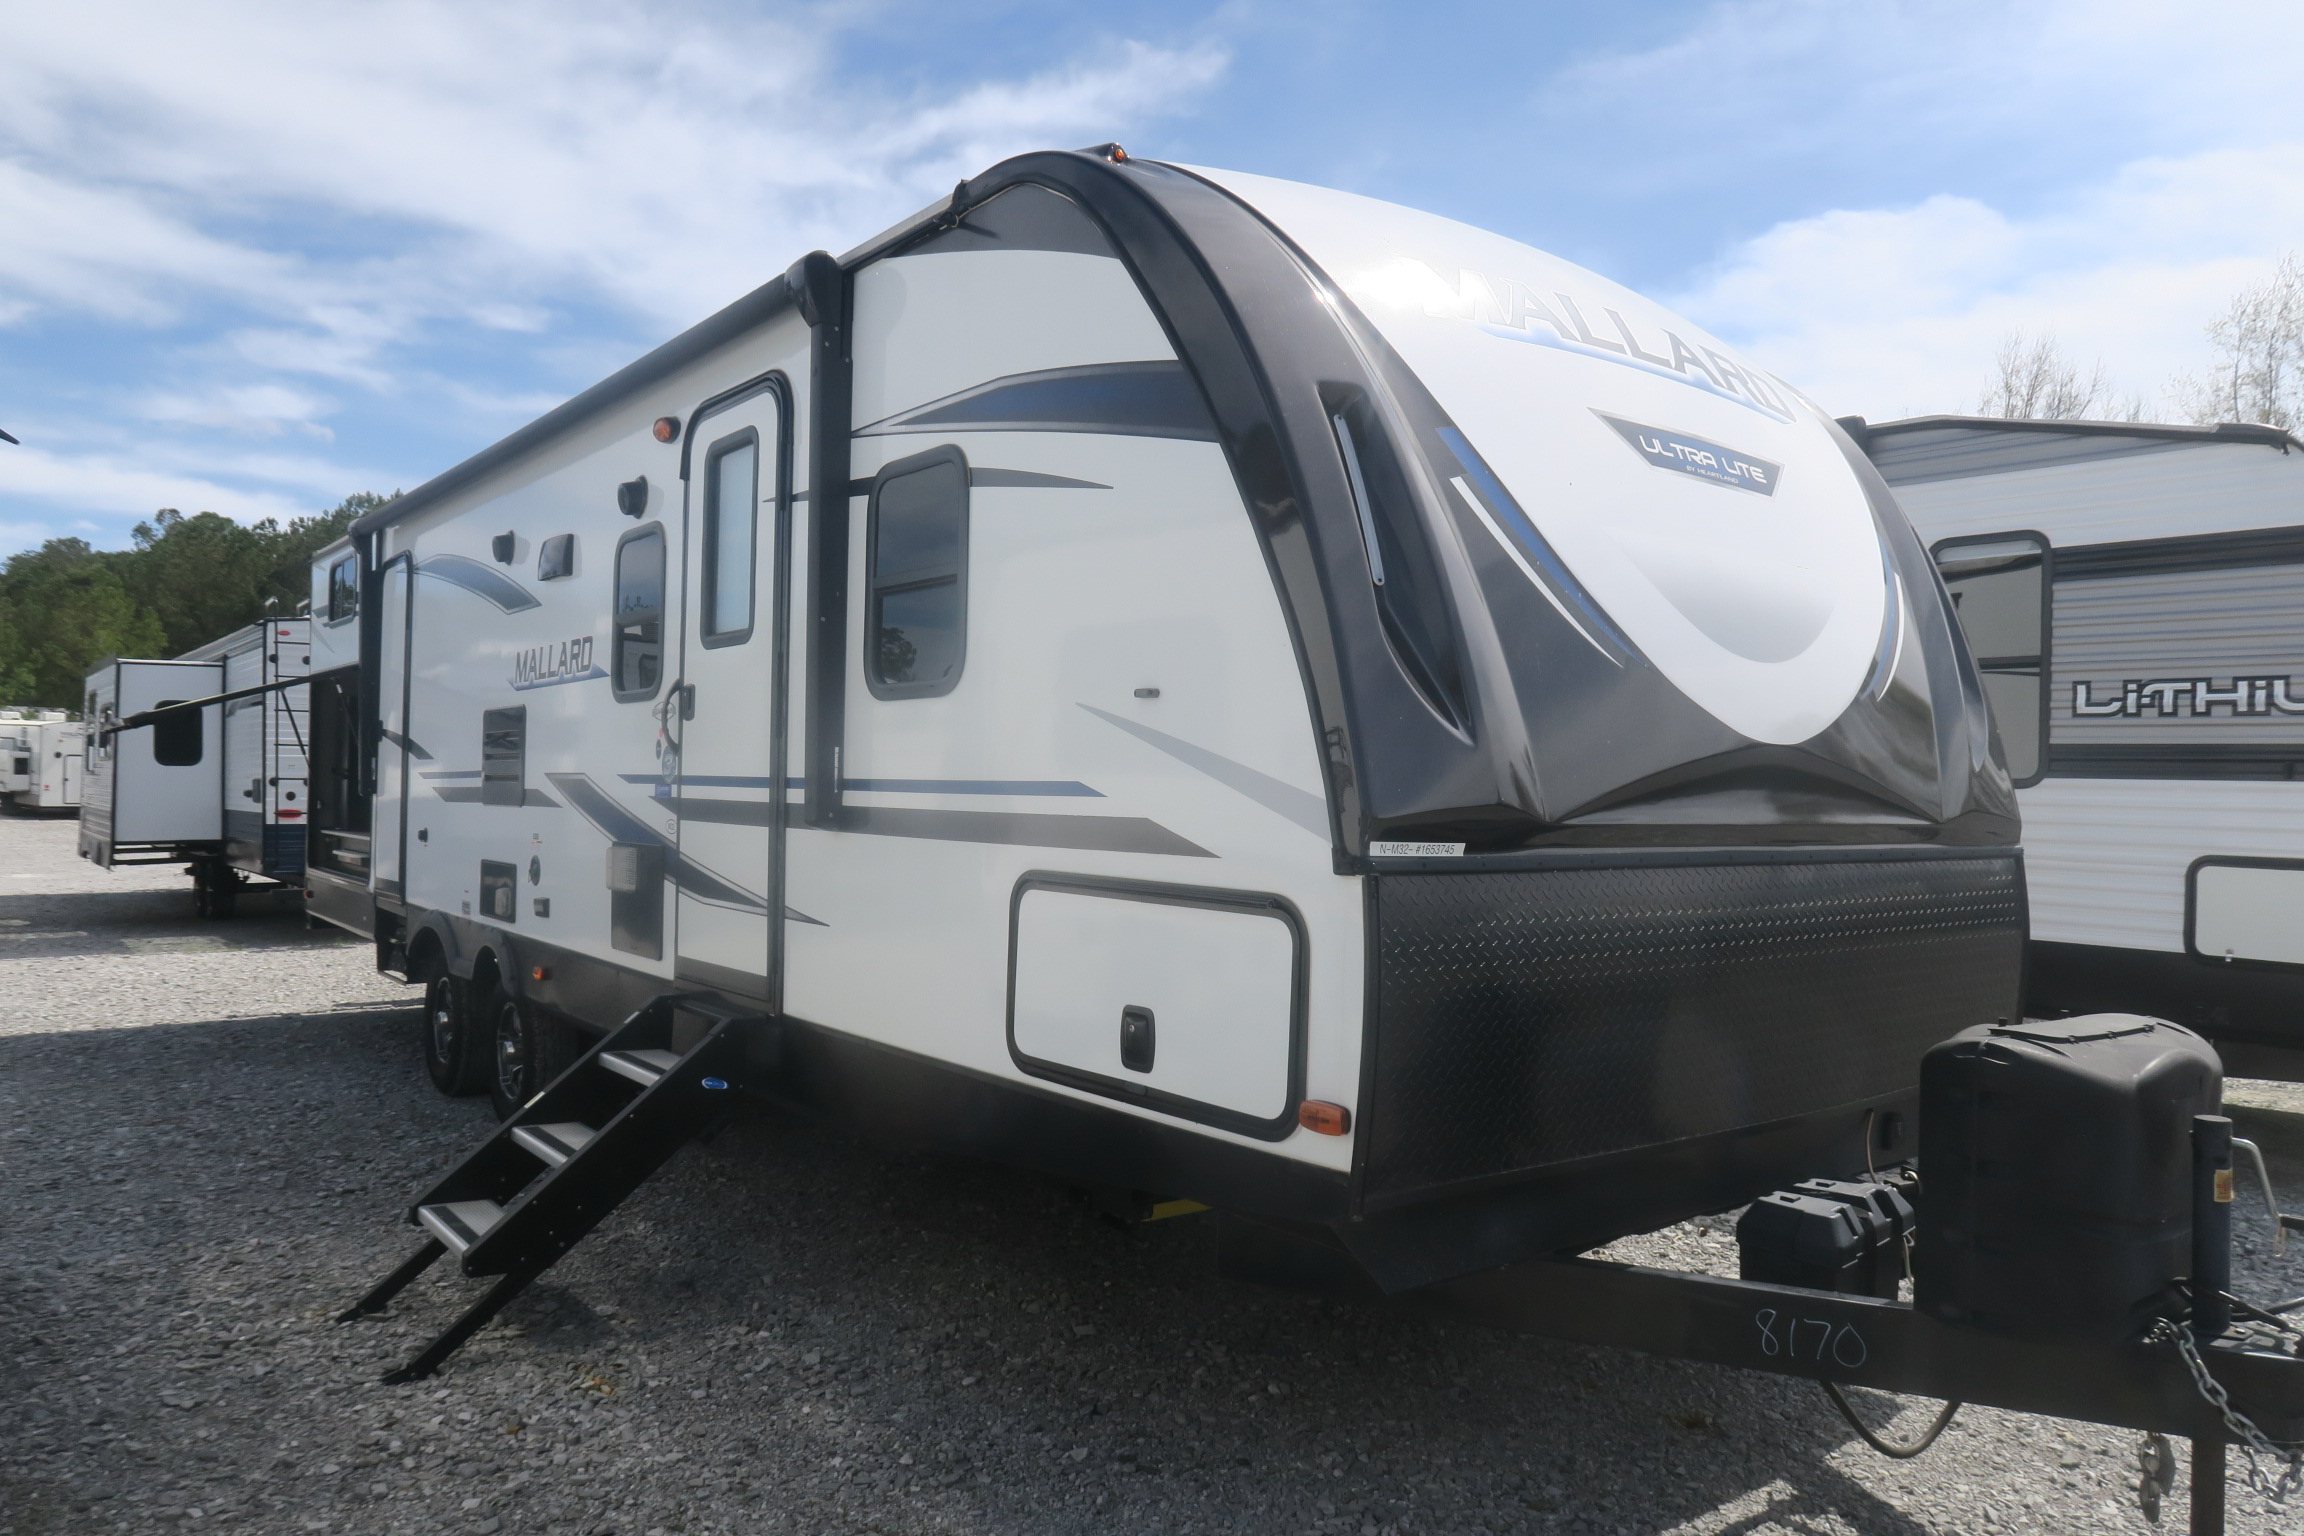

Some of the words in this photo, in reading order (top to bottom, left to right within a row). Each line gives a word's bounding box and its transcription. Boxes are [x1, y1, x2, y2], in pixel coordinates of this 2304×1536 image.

[1392, 254, 1798, 422] MALLARD
[1638, 434, 1719, 469] ULTRA
[1721, 456, 1768, 484] LITE
[1685, 465, 1695, 473] BY
[1696, 467, 1739, 484] HEARTLAND
[514, 635, 594, 684] MALLARD
[1415, 844, 1456, 855] #1653745
[1755, 1308, 1867, 1368] 8170
